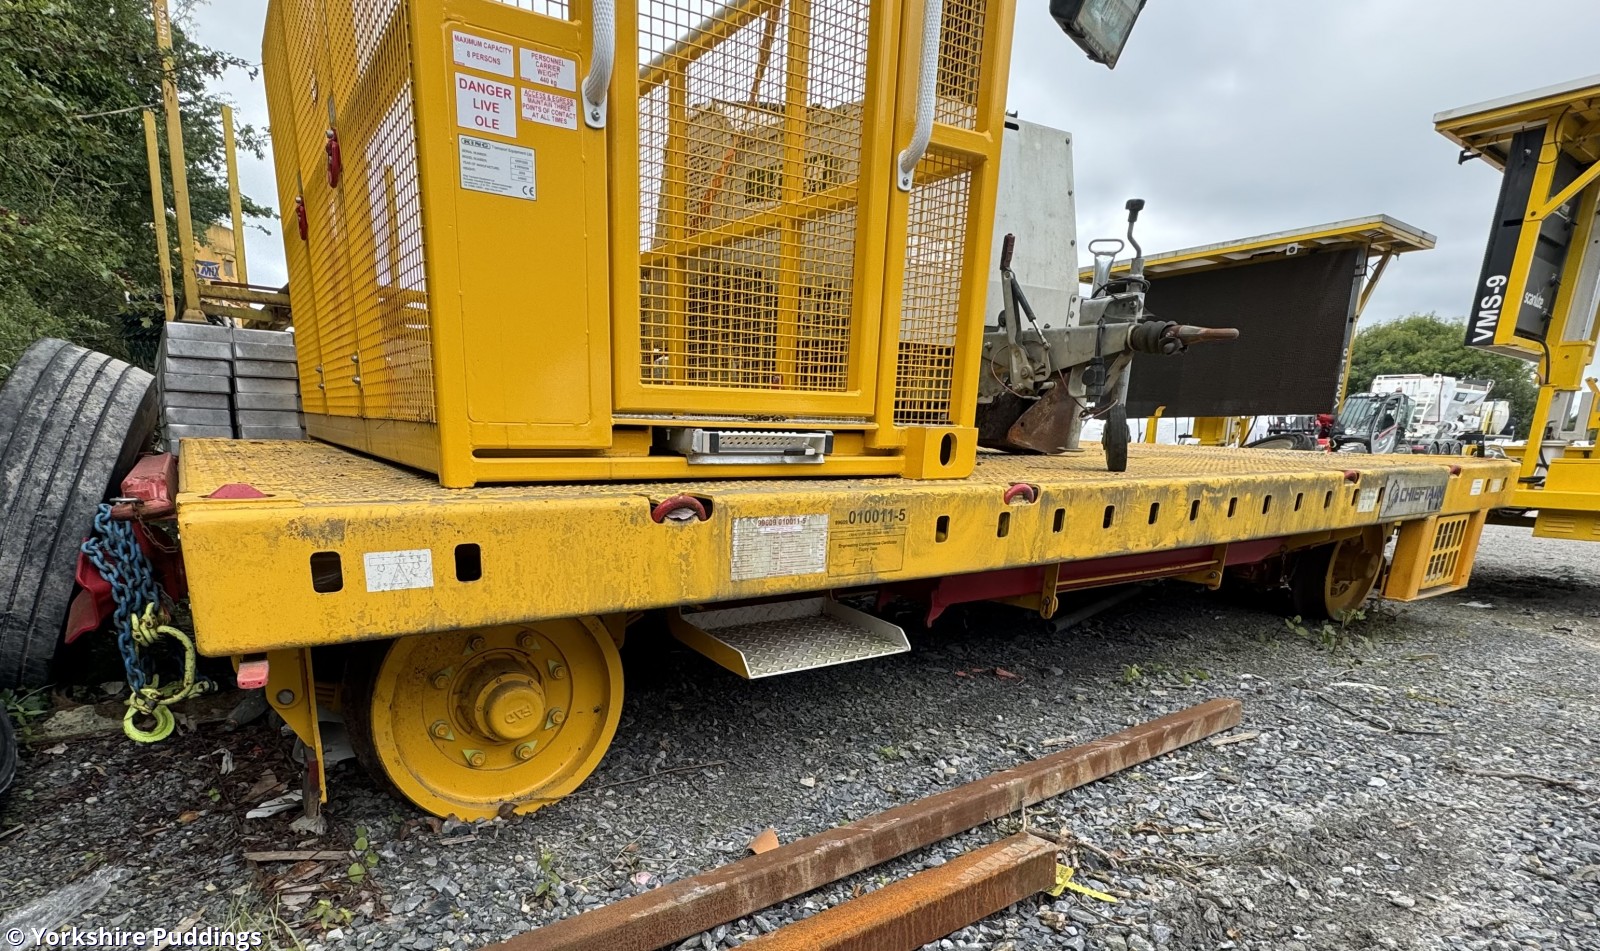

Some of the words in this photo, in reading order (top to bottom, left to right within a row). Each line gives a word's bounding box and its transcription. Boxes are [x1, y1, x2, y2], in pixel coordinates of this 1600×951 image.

[454, 35, 482, 47] MAXIMUM
[484, 43, 511, 54] CAPACITY
[472, 52, 501, 65] PERSONS
[531, 53, 565, 67] PERSONNEL
[536, 61, 560, 72] CARRIER
[537, 69, 559, 79] WEIGHT
[459, 78, 512, 100] DANGER
[473, 98, 500, 113] LIVE
[524, 90, 546, 100] ACCESS
[552, 96, 574, 107] EGRESS
[528, 98, 552, 108] MAINTAIN
[554, 103, 571, 112] THREE
[523, 103, 541, 112] POINTS
[551, 109, 575, 119] CONTACT
[475, 115, 500, 130] OLE
[552, 116, 567, 125] TIMES
[1472, 275, 1507, 343] VMS-9
[1334, 348, 1349, 409] VMS-10
[1399, 486, 1445, 502] CHIEFTAIN
[778, 517, 806, 526] 010011-5
[849, 508, 906, 524] 010011-5
